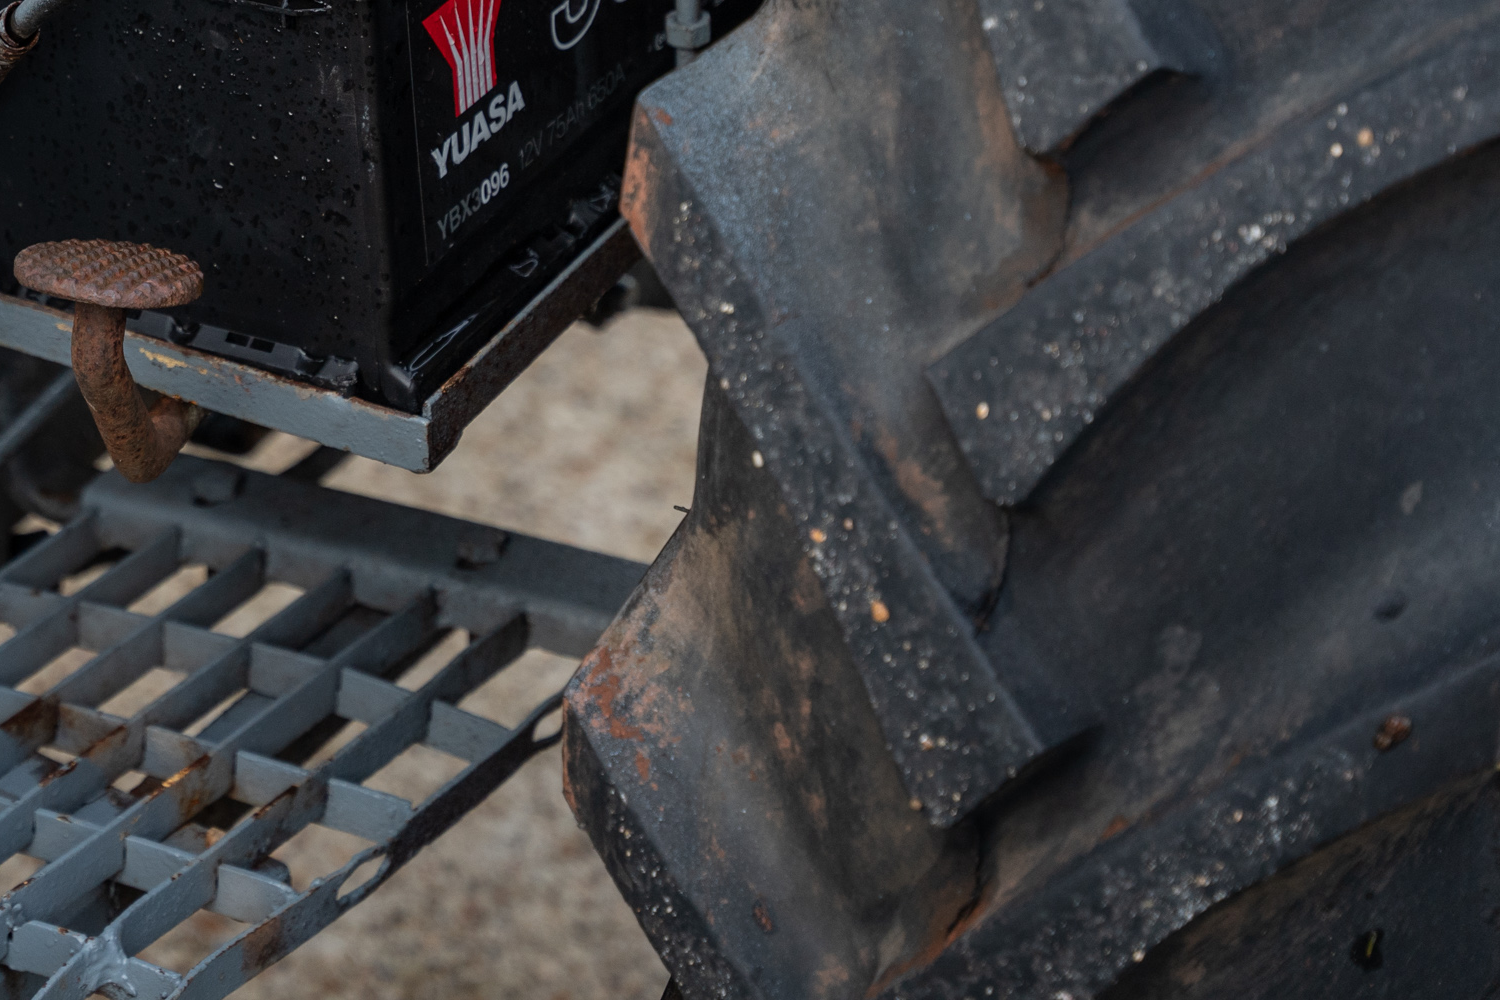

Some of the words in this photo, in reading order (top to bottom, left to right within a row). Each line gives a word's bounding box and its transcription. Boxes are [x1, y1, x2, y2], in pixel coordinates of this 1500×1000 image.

[430, 80, 526, 179] YUASA
[437, 162, 510, 241] YBX3096
[517, 130, 543, 171] 12V
[547, 98, 585, 147] 75Ah
